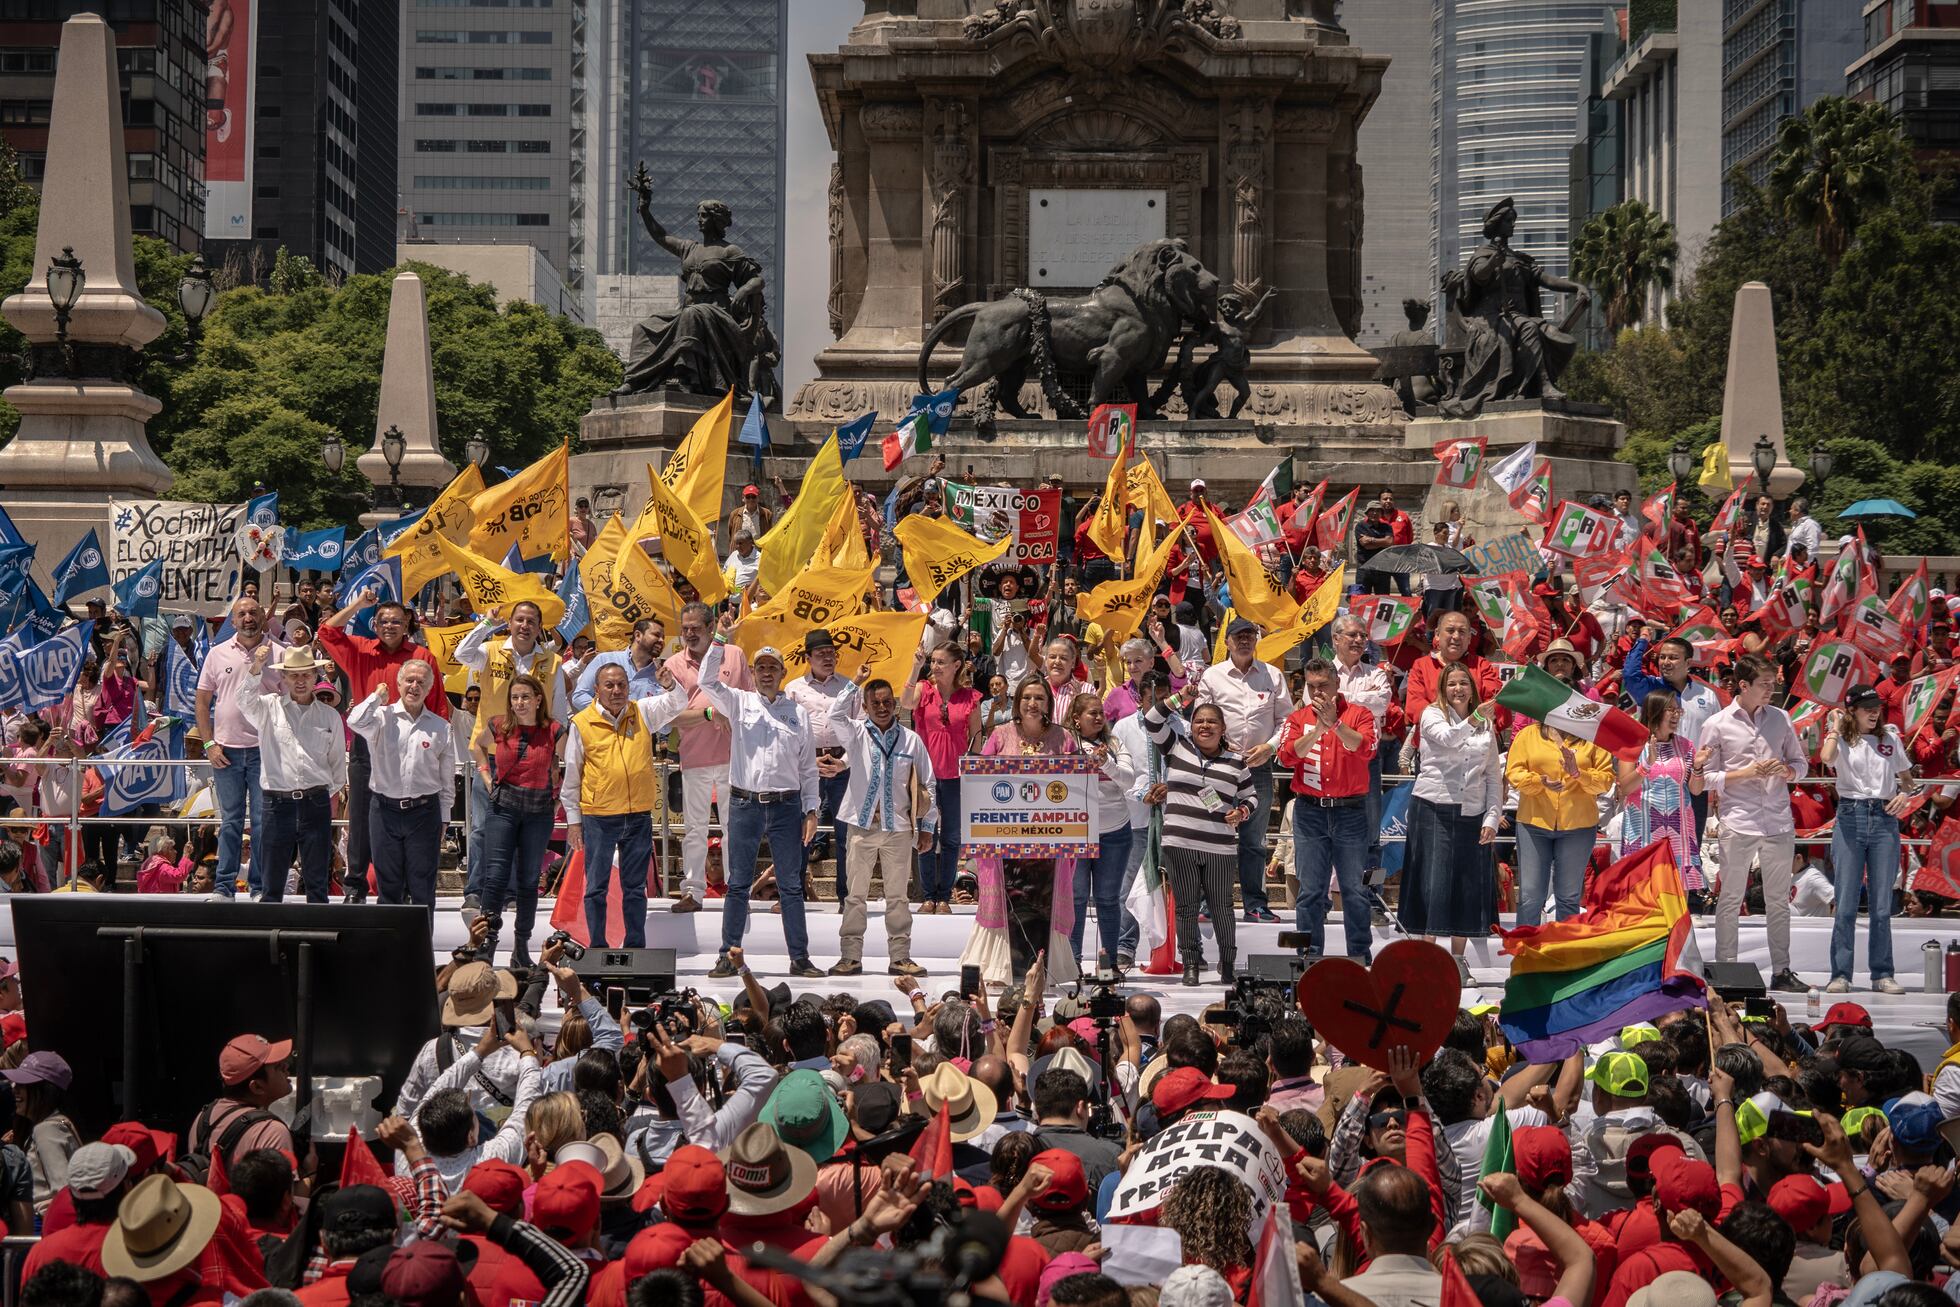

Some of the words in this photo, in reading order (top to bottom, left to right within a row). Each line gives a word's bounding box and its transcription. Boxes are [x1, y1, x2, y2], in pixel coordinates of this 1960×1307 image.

[956, 489, 1041, 512] MÉXICO
[1562, 515, 1604, 547] PRI
[634, 594, 651, 614] HUGO
[1810, 648, 1860, 685] PRI
[995, 786, 1010, 798] PAN
[1022, 784, 1039, 798] PRI
[970, 812, 1029, 823] FRENTE
[1031, 812, 1089, 823] AMPLIO
[996, 826, 1018, 835] POR
[1021, 824, 1063, 835] MÉXICO
[1182, 1112, 1216, 1121] CDMX
[1133, 1122, 1263, 1160] MILPA
[1145, 1144, 1249, 1173] ALTA
[733, 1166, 768, 1182] CDMX
